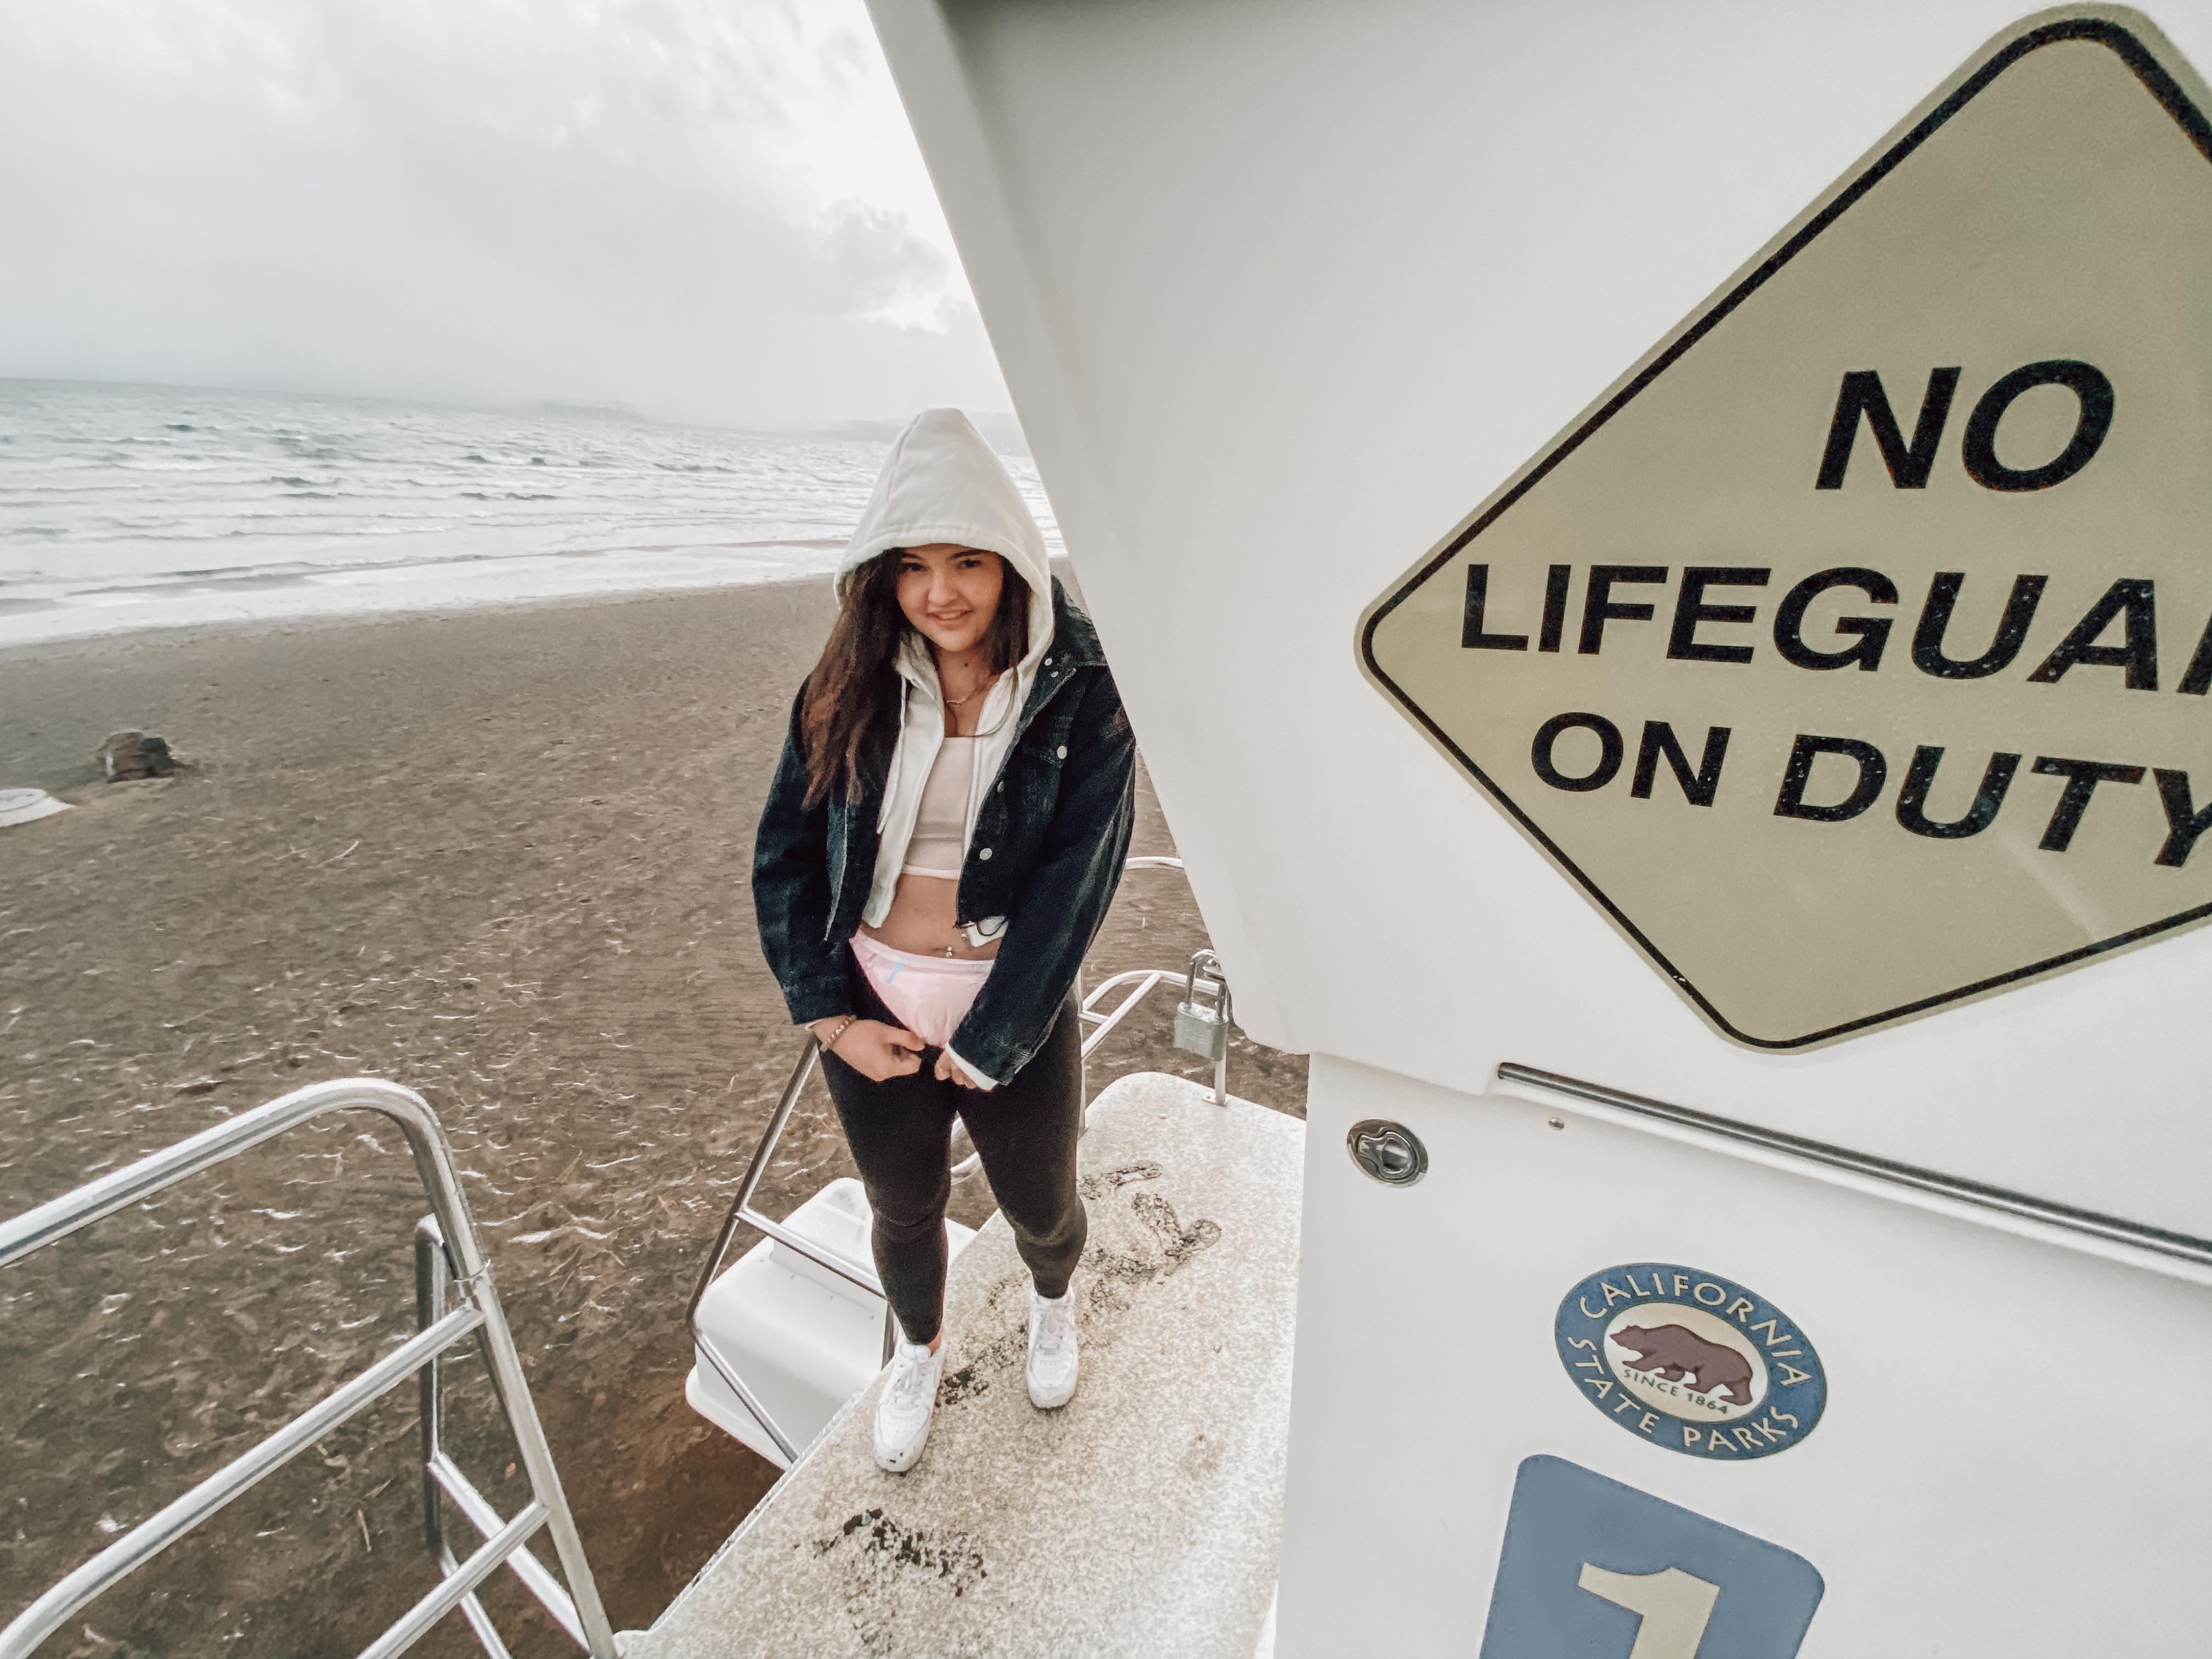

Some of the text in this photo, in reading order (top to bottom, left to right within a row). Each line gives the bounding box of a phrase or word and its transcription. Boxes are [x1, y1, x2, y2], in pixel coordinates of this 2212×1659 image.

[1815, 360, 2115, 493] NO
[1531, 712, 2212, 868] ON DUTY
[1580, 1273, 1812, 1387] CALIFORNIA
[1567, 1336, 1799, 1452] STATE PARKS
[1624, 1369, 1729, 1414] SINCE 1864
[1578, 1561, 1720, 1659] 1
